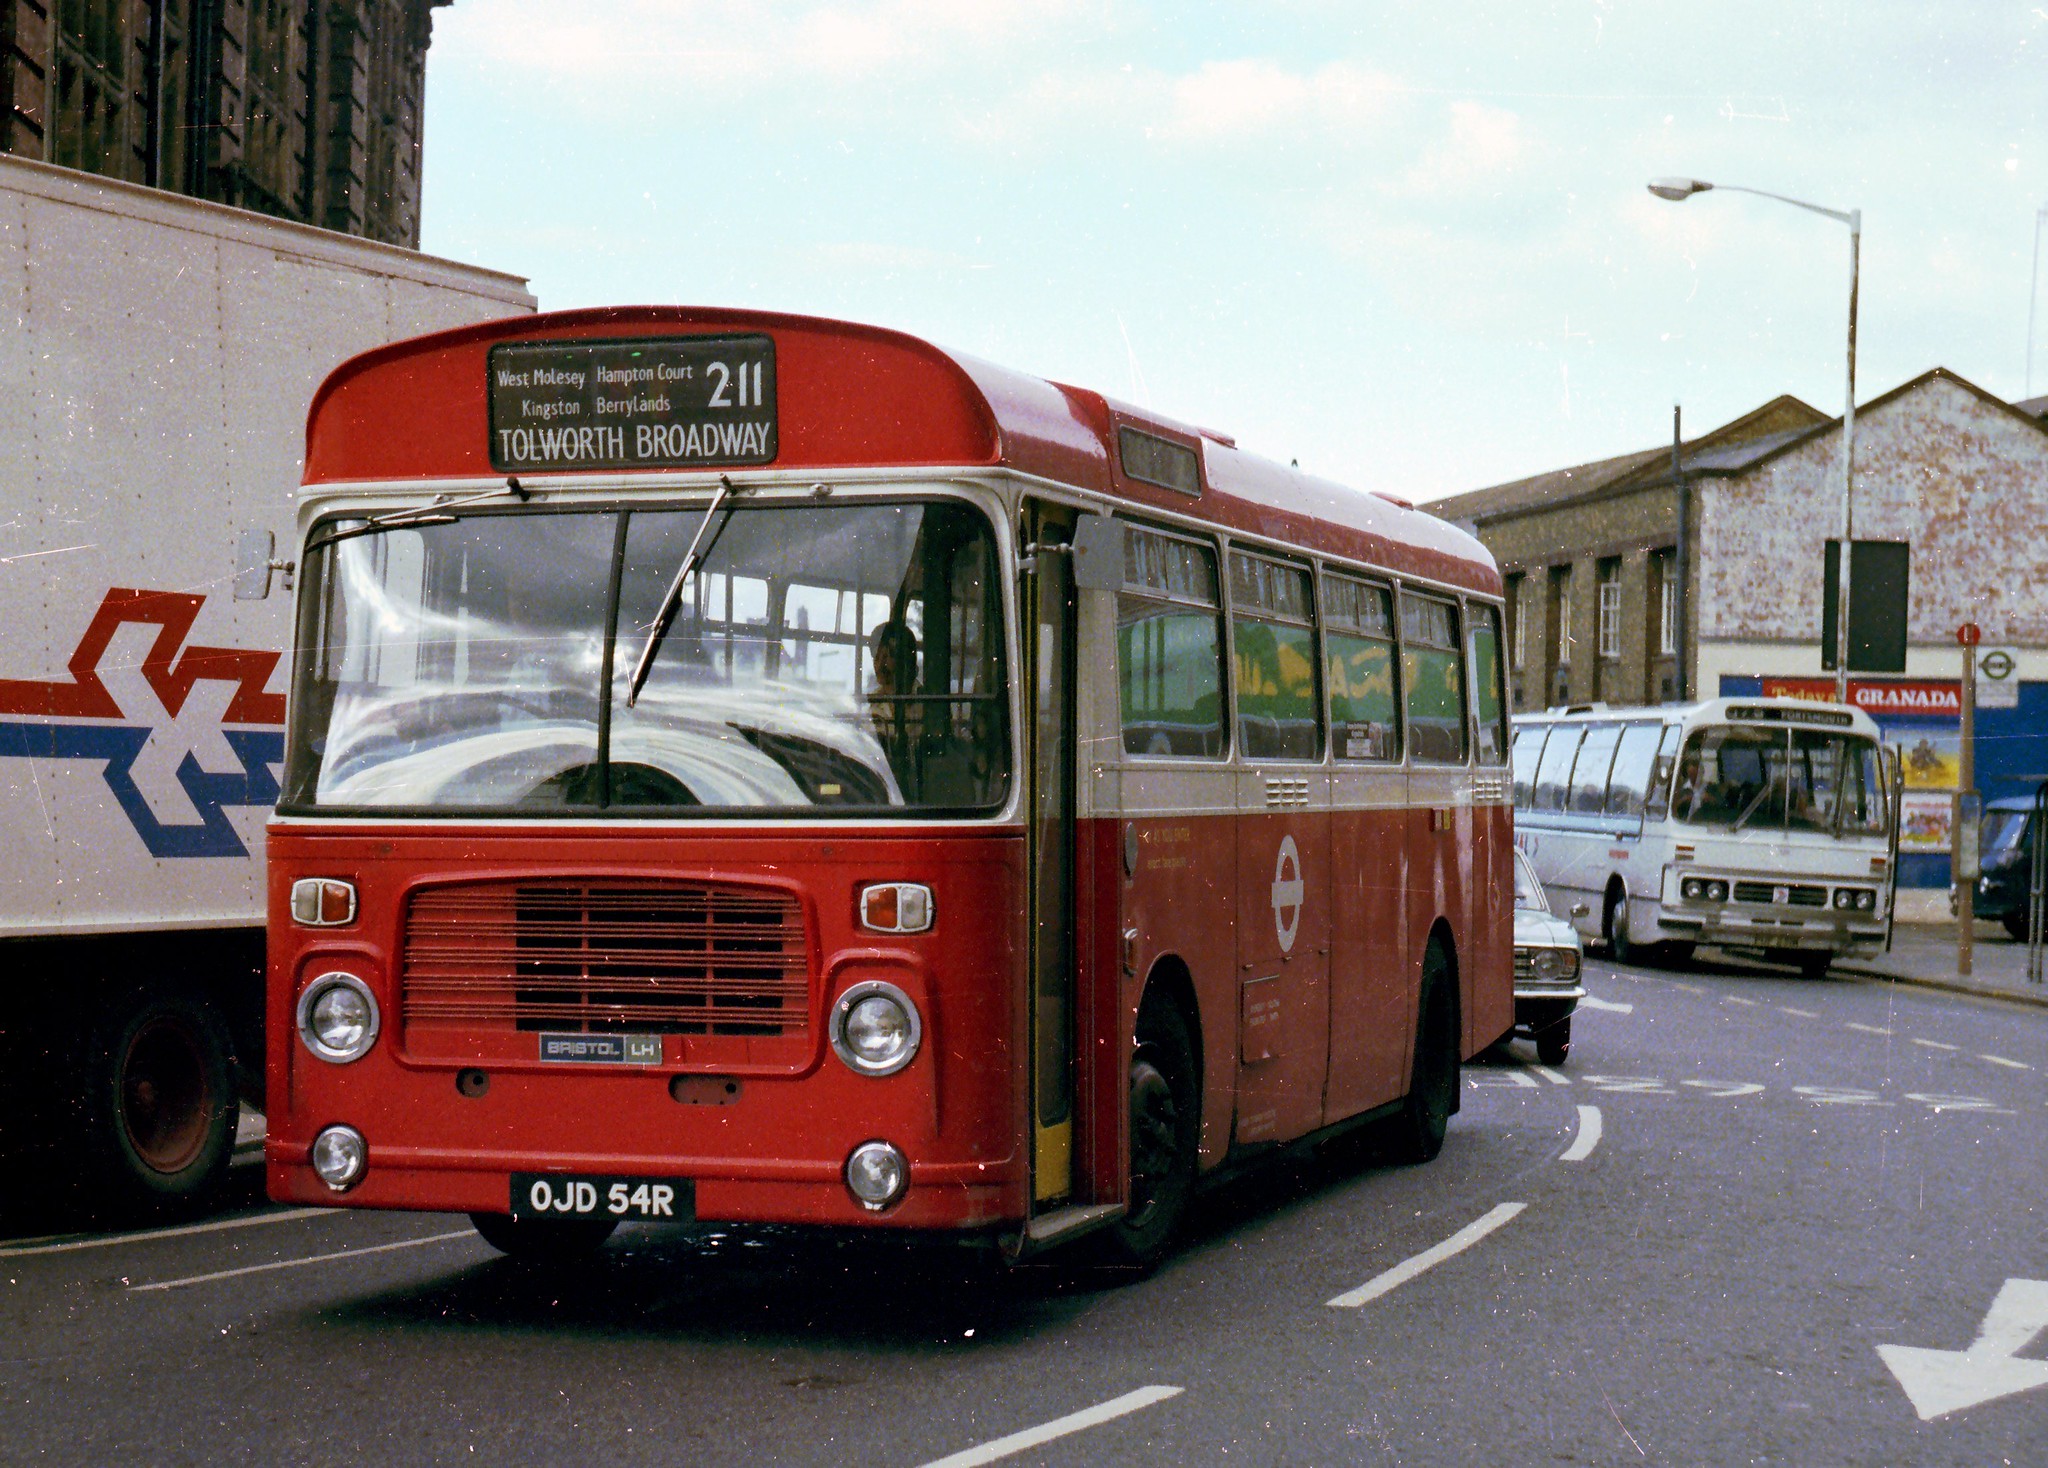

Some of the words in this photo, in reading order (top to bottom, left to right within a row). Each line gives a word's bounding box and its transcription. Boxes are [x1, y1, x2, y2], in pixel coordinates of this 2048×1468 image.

[497, 369, 529, 388] West
[533, 368, 586, 390] Molesey
[597, 365, 654, 386] Hampton
[657, 362, 694, 381] Court
[706, 360, 763, 408] 211
[521, 397, 581, 420] Kingston
[596, 394, 671, 417] Berrylands
[499, 425, 625, 462] TOLWORTH
[636, 421, 771, 459] BROADWAY
[1855, 687, 1959, 706] GRANADA
[547, 1041, 620, 1055] BRISTOL
[631, 1043, 654, 1056] LH
[530, 1180, 597, 1213] OJD
[608, 1183, 674, 1216] 54R
